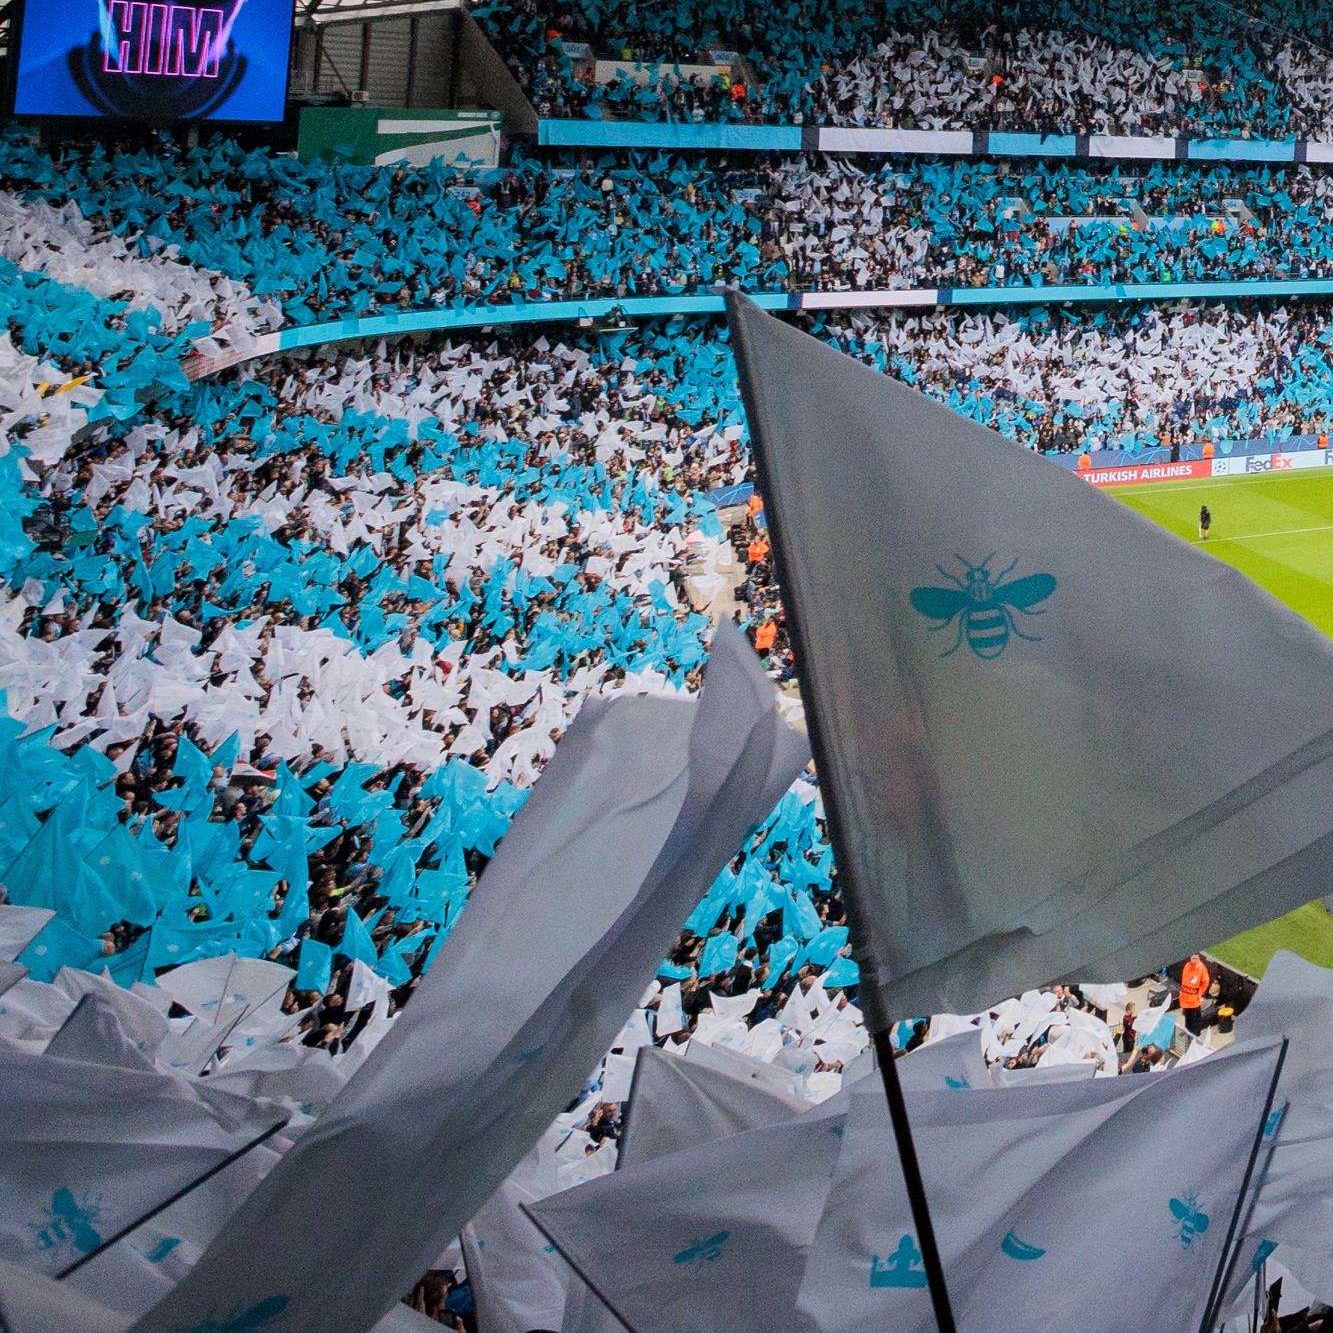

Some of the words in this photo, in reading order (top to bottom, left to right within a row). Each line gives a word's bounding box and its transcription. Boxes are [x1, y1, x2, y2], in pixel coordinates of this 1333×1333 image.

[103, 0, 224, 78] HIM
[1245, 454, 1293, 472] FedEx
[1083, 469, 1138, 484] TURKISH
[1140, 465, 1193, 479] AIRLINES
